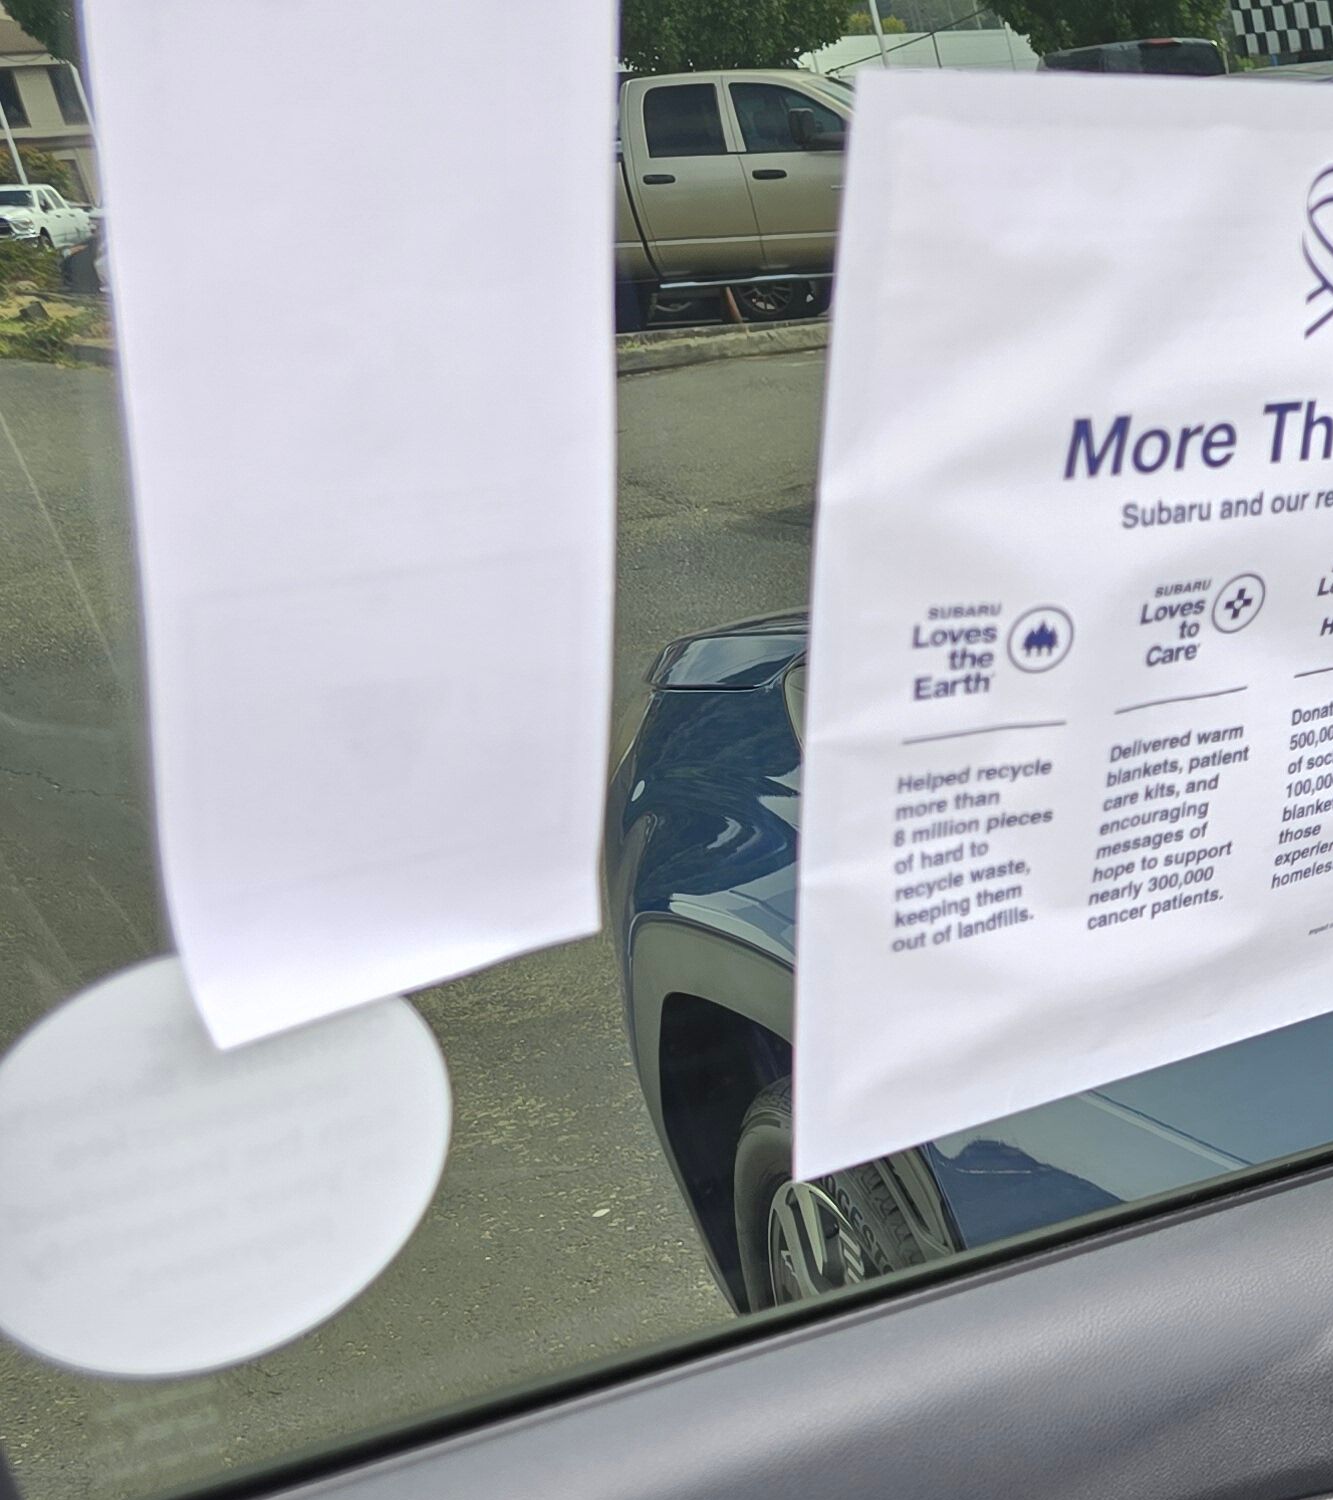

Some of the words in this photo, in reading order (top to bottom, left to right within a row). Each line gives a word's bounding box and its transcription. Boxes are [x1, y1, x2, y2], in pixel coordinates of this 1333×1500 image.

[1063, 414, 1237, 480] More
[1122, 500, 1211, 529] Subaru
[1220, 491, 1264, 520] and
[1271, 492, 1310, 514] our
[1155, 579, 1211, 598] SUBARU
[928, 604, 1001, 620] SUBARU
[1140, 599, 1206, 625] Loves
[1179, 620, 1200, 639] to
[911, 625, 998, 650] Loves
[948, 650, 995, 672] the
[1145, 644, 1198, 667] Care
[913, 674, 990, 701] Earth
[1110, 730, 1192, 763] Delivered
[1197, 726, 1244, 745] warm
[897, 767, 971, 793] Helped
[977, 759, 1052, 782] recycle
[1106, 759, 1183, 787] blankets,
[1188, 746, 1250, 774] patient
[1288, 755, 1304, 775] of
[896, 800, 948, 820] more
[954, 792, 1000, 809] than
[1103, 792, 1139, 812] care
[1144, 783, 1180, 801] kits,
[1185, 773, 1220, 794] and
[894, 829, 905, 847] 8
[912, 819, 980, 843] million
[986, 811, 1053, 834] pieces
[1099, 801, 1209, 836] encouraging
[1278, 824, 1321, 845] those
[1096, 829, 1184, 859] messages
[1189, 821, 1208, 839] of
[894, 854, 914, 874] of
[920, 843, 963, 869] hard
[969, 842, 989, 857] to
[1092, 862, 1135, 883] hope
[1141, 856, 1158, 871] to
[1163, 841, 1232, 867] support
[895, 872, 964, 901] recycle
[970, 860, 1030, 883] waste,
[1088, 881, 1143, 905] nearly
[1148, 866, 1214, 892] 300,000
[895, 897, 970, 927] keeping
[976, 885, 1022, 907] them
[1087, 904, 1147, 930] cancer
[1151, 888, 1223, 919] patients.
[892, 932, 926, 952] out
[933, 925, 952, 945] of
[958, 907, 1033, 939] landfills.
